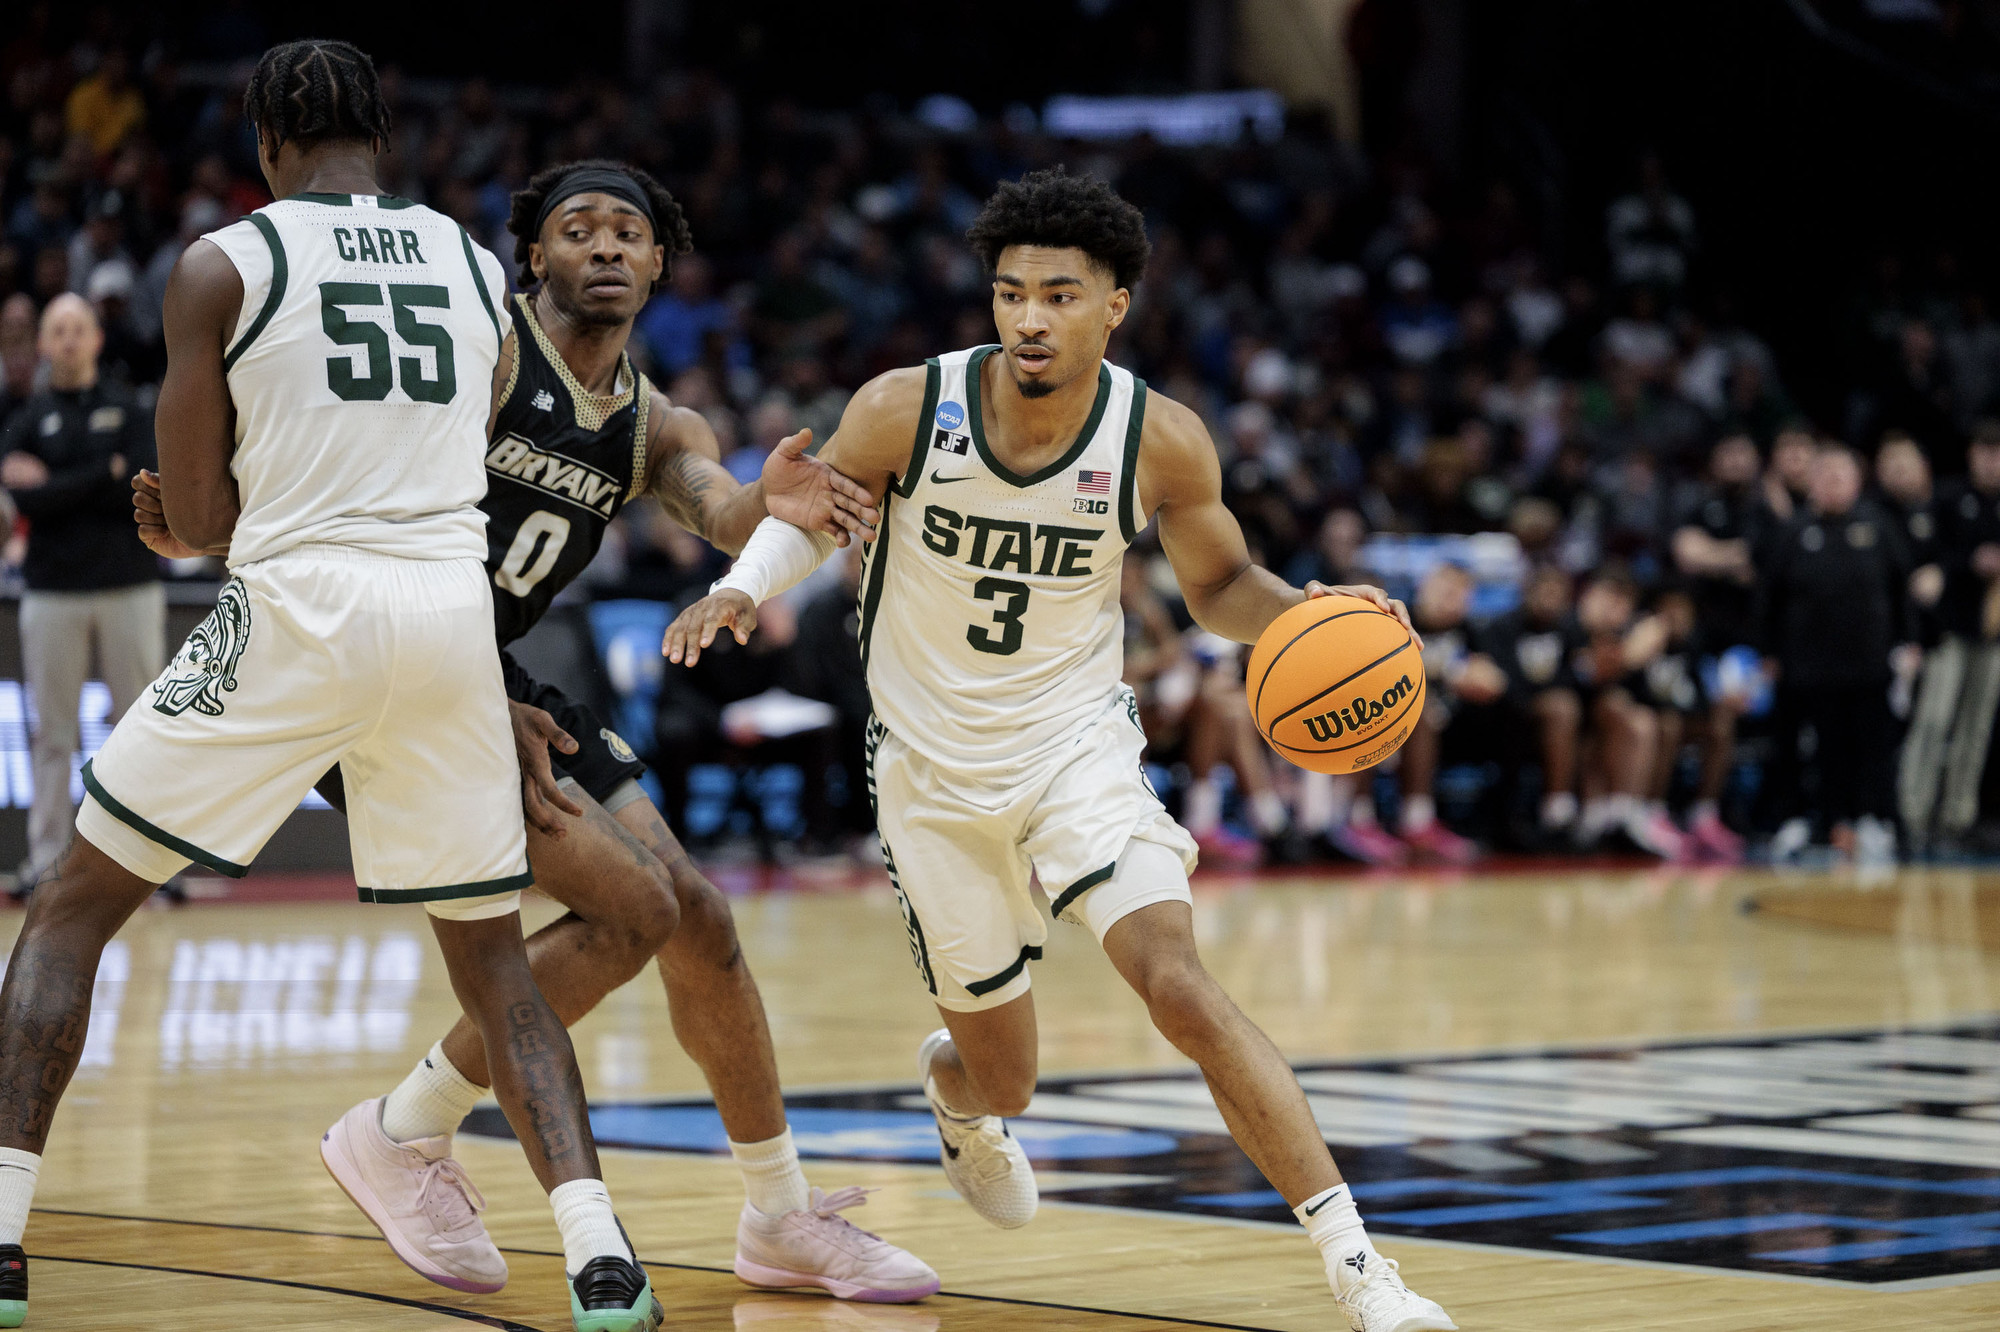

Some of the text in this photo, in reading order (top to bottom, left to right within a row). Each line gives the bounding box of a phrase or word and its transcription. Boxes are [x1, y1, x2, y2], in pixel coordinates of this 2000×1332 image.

[333, 227, 428, 264] CARR
[318, 281, 457, 405] 55
[937, 411, 961, 426] NCAA
[941, 432, 963, 452] JF
[495, 510, 571, 598] 0
[922, 504, 1106, 577] STATE
[966, 576, 1030, 656] 3
[1302, 674, 1414, 743] Wilson
[1356, 713, 1389, 736] EVO NXT
